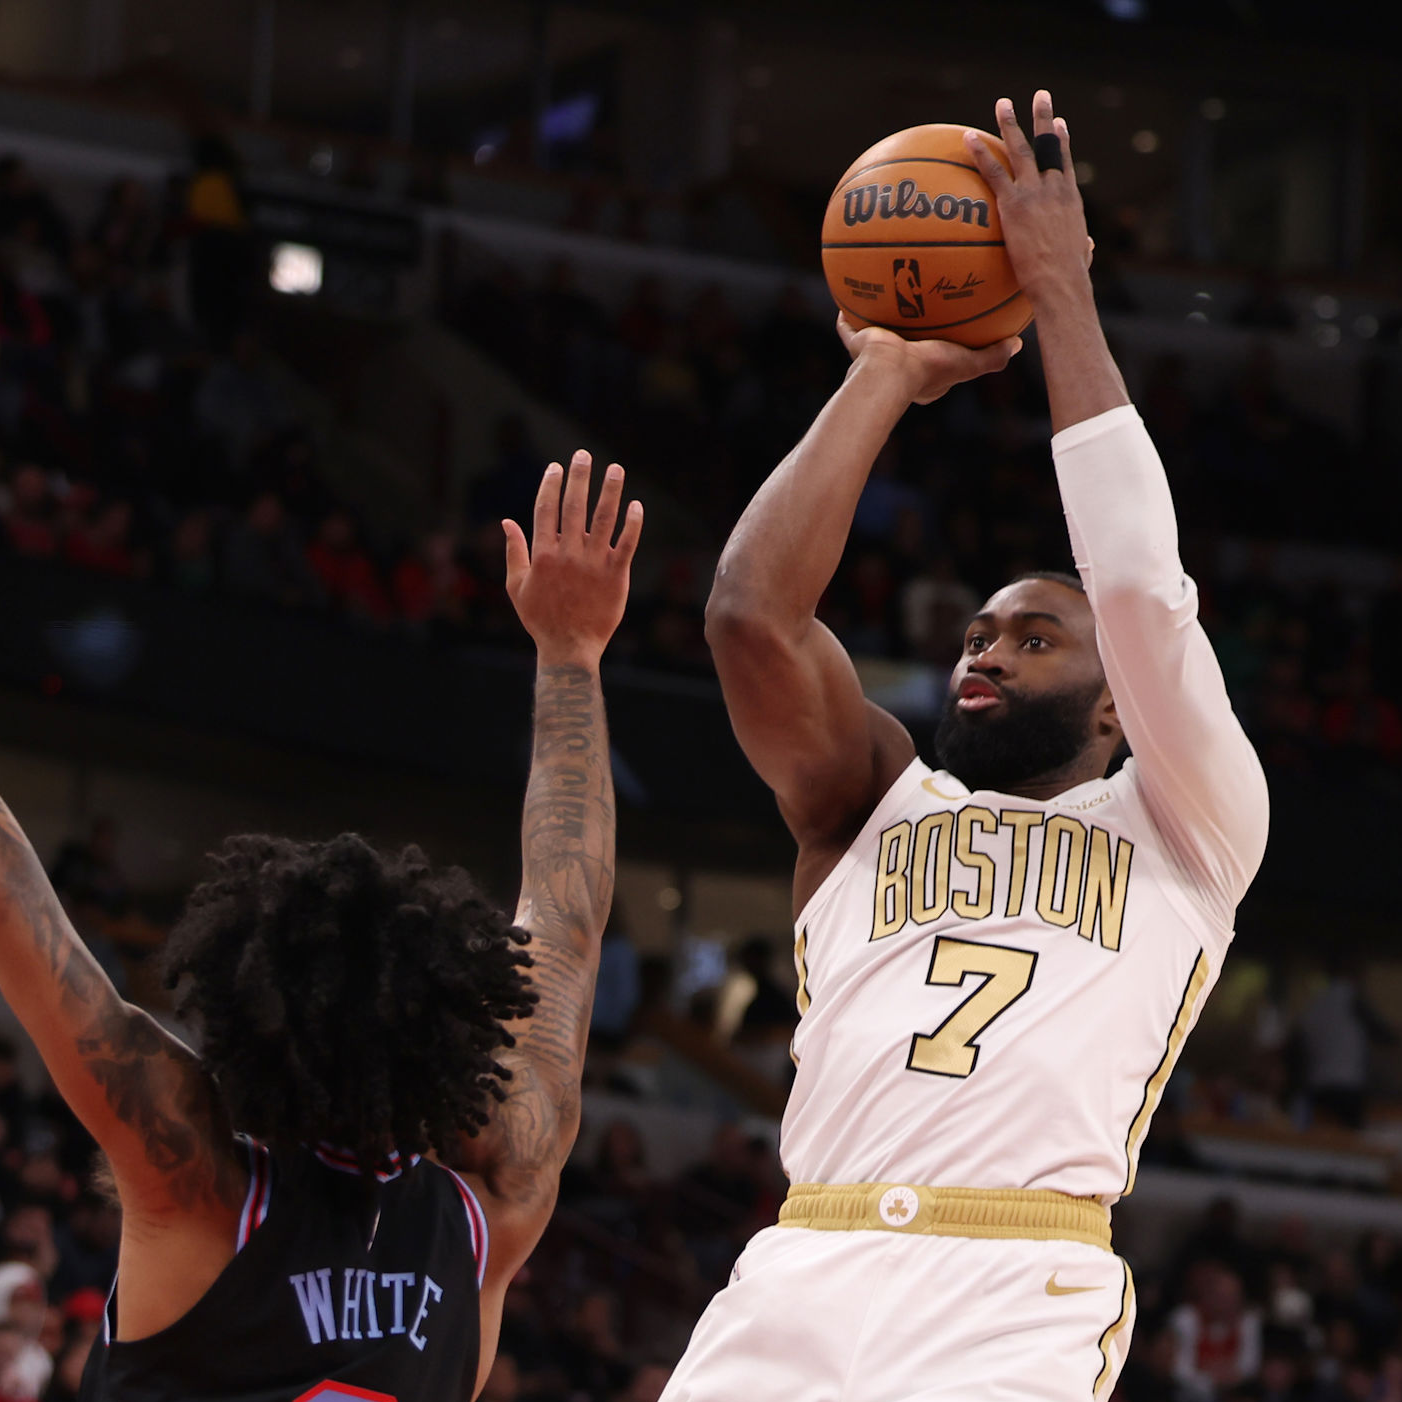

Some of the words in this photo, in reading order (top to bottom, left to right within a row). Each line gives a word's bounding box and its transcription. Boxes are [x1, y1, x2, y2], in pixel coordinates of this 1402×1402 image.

[843, 178, 990, 228] Wilson
[869, 805, 1134, 952] BOSTON
[906, 935, 1039, 1079] 7
[289, 1267, 443, 1351] WHITE
